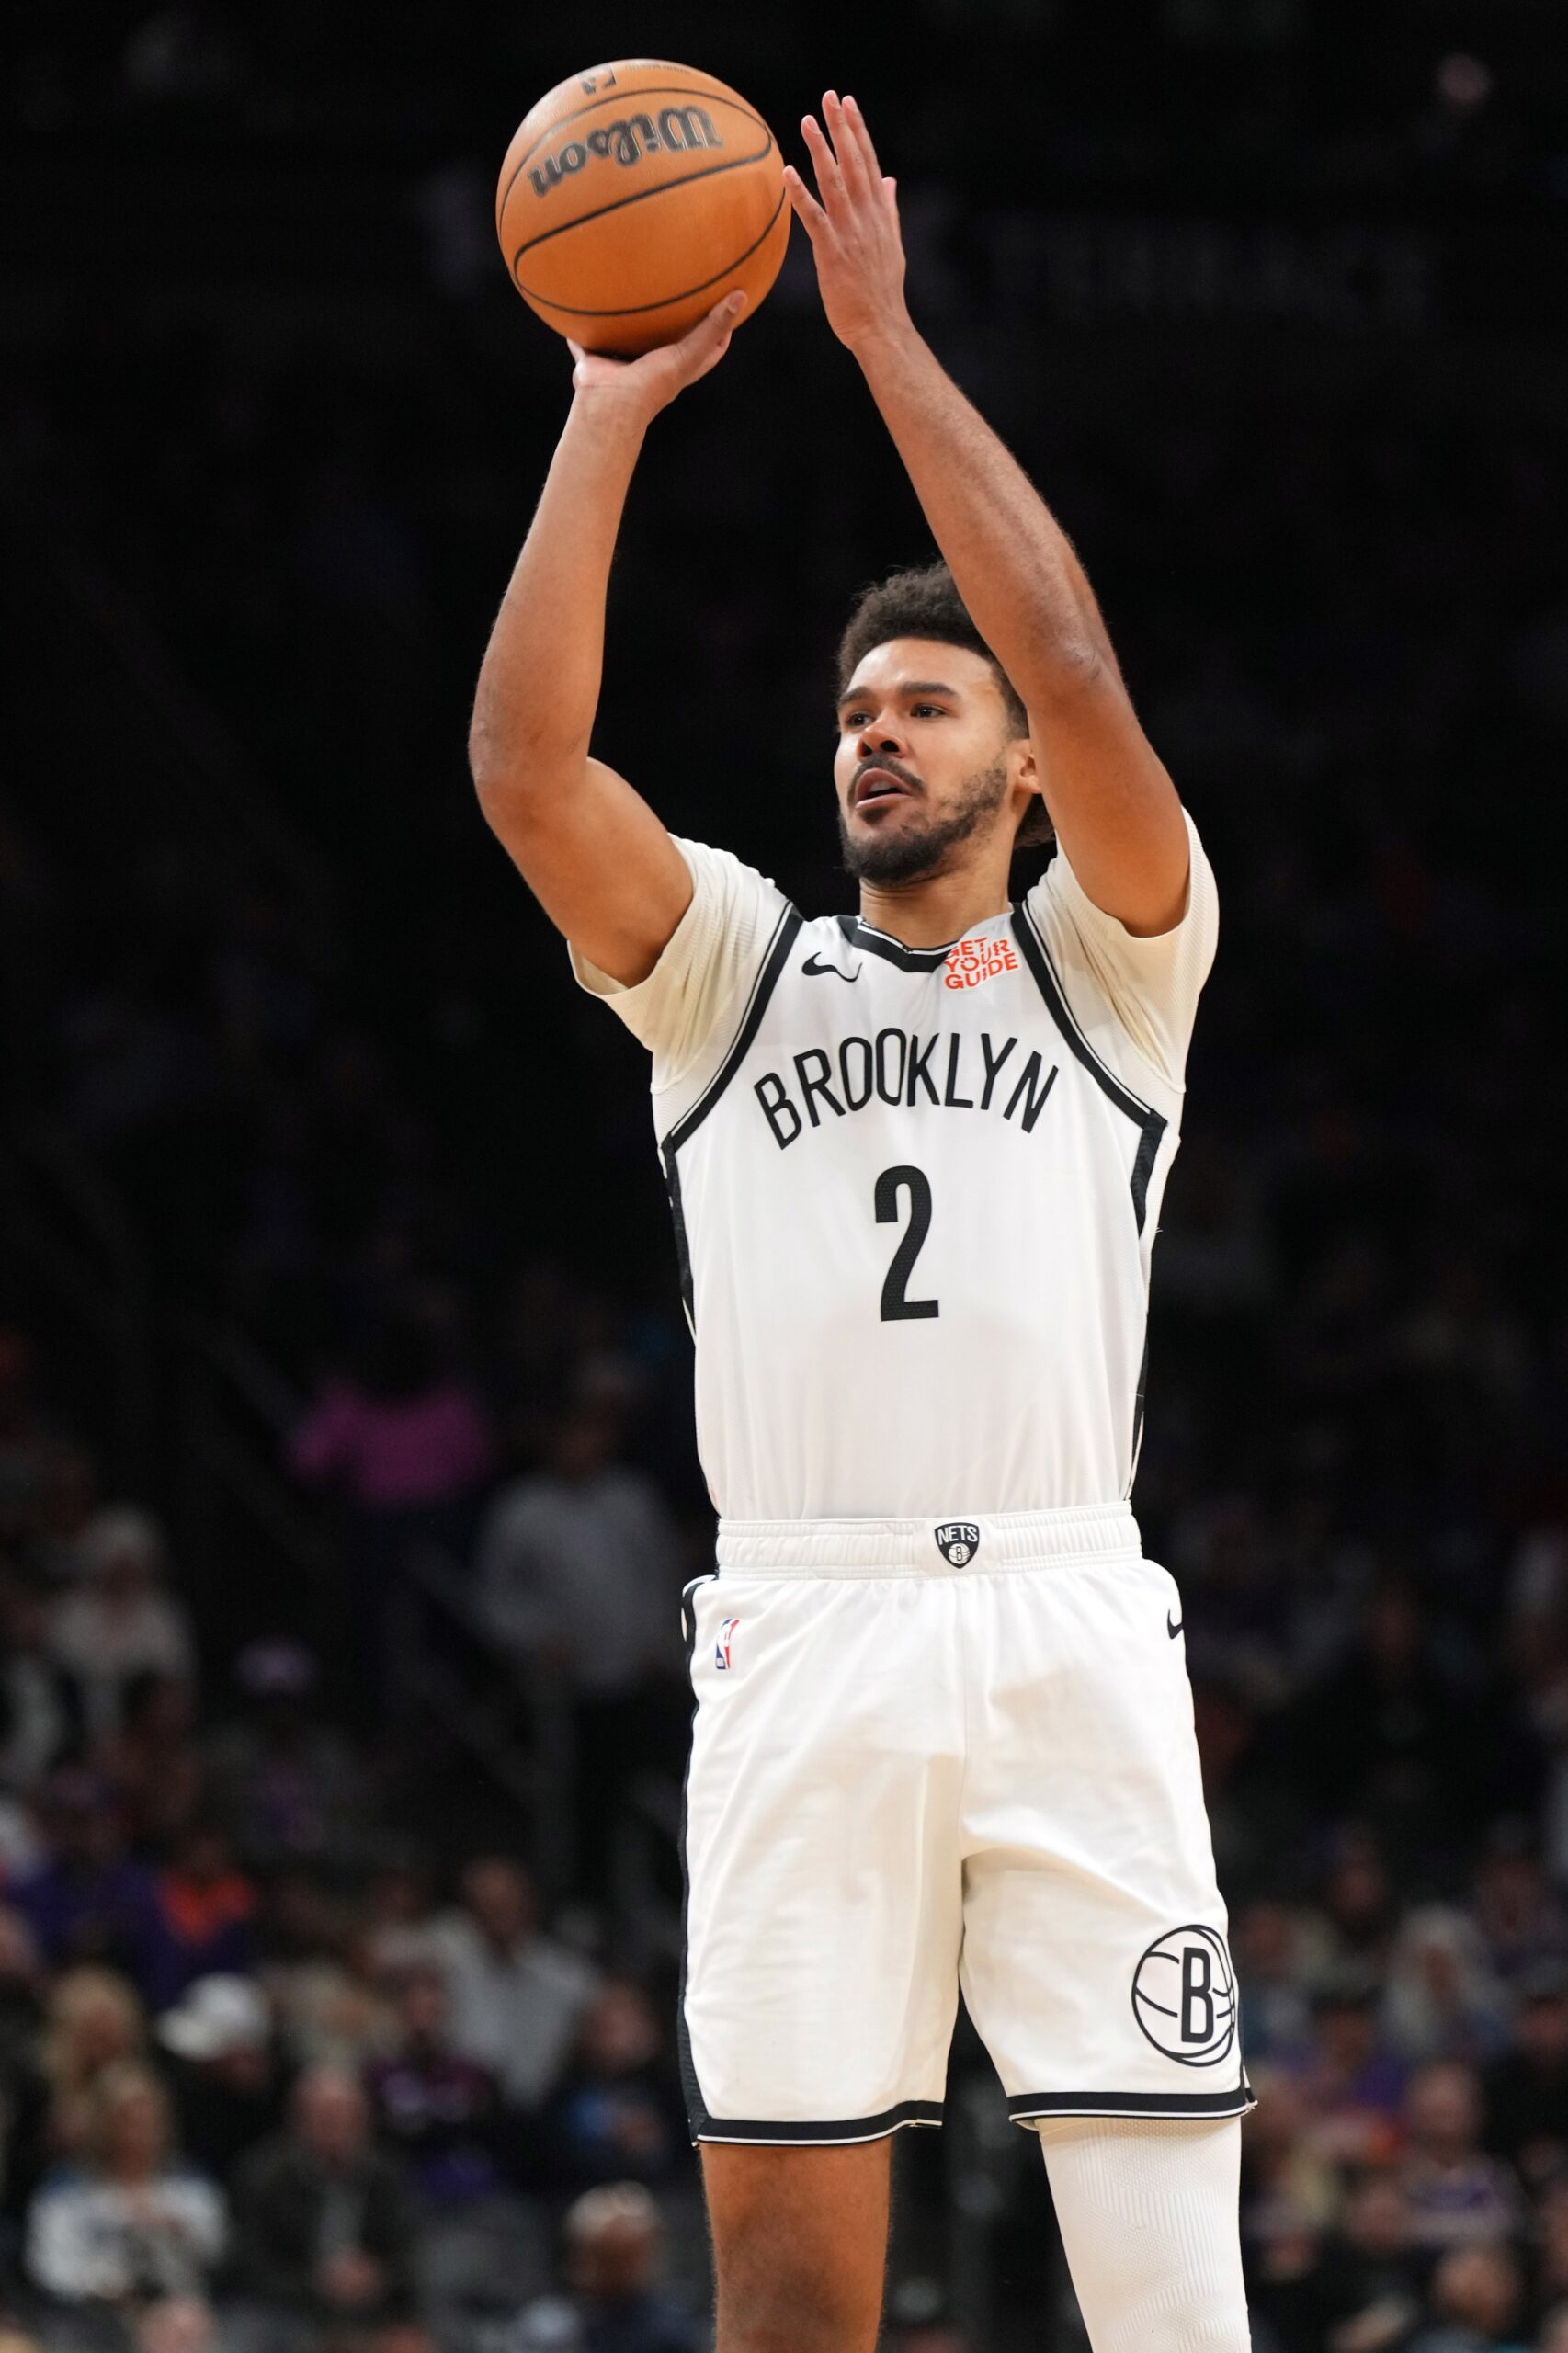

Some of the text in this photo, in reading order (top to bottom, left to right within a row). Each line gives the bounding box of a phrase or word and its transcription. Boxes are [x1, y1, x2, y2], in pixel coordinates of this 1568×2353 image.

[527, 106, 723, 197] Wilson
[945, 952, 1018, 989] GUIDE
[754, 1027, 1059, 1151] BROOKLYN
[874, 1165, 939, 1322] 2
[937, 1525, 978, 1546] NETS
[1181, 1947, 1214, 2043] B
